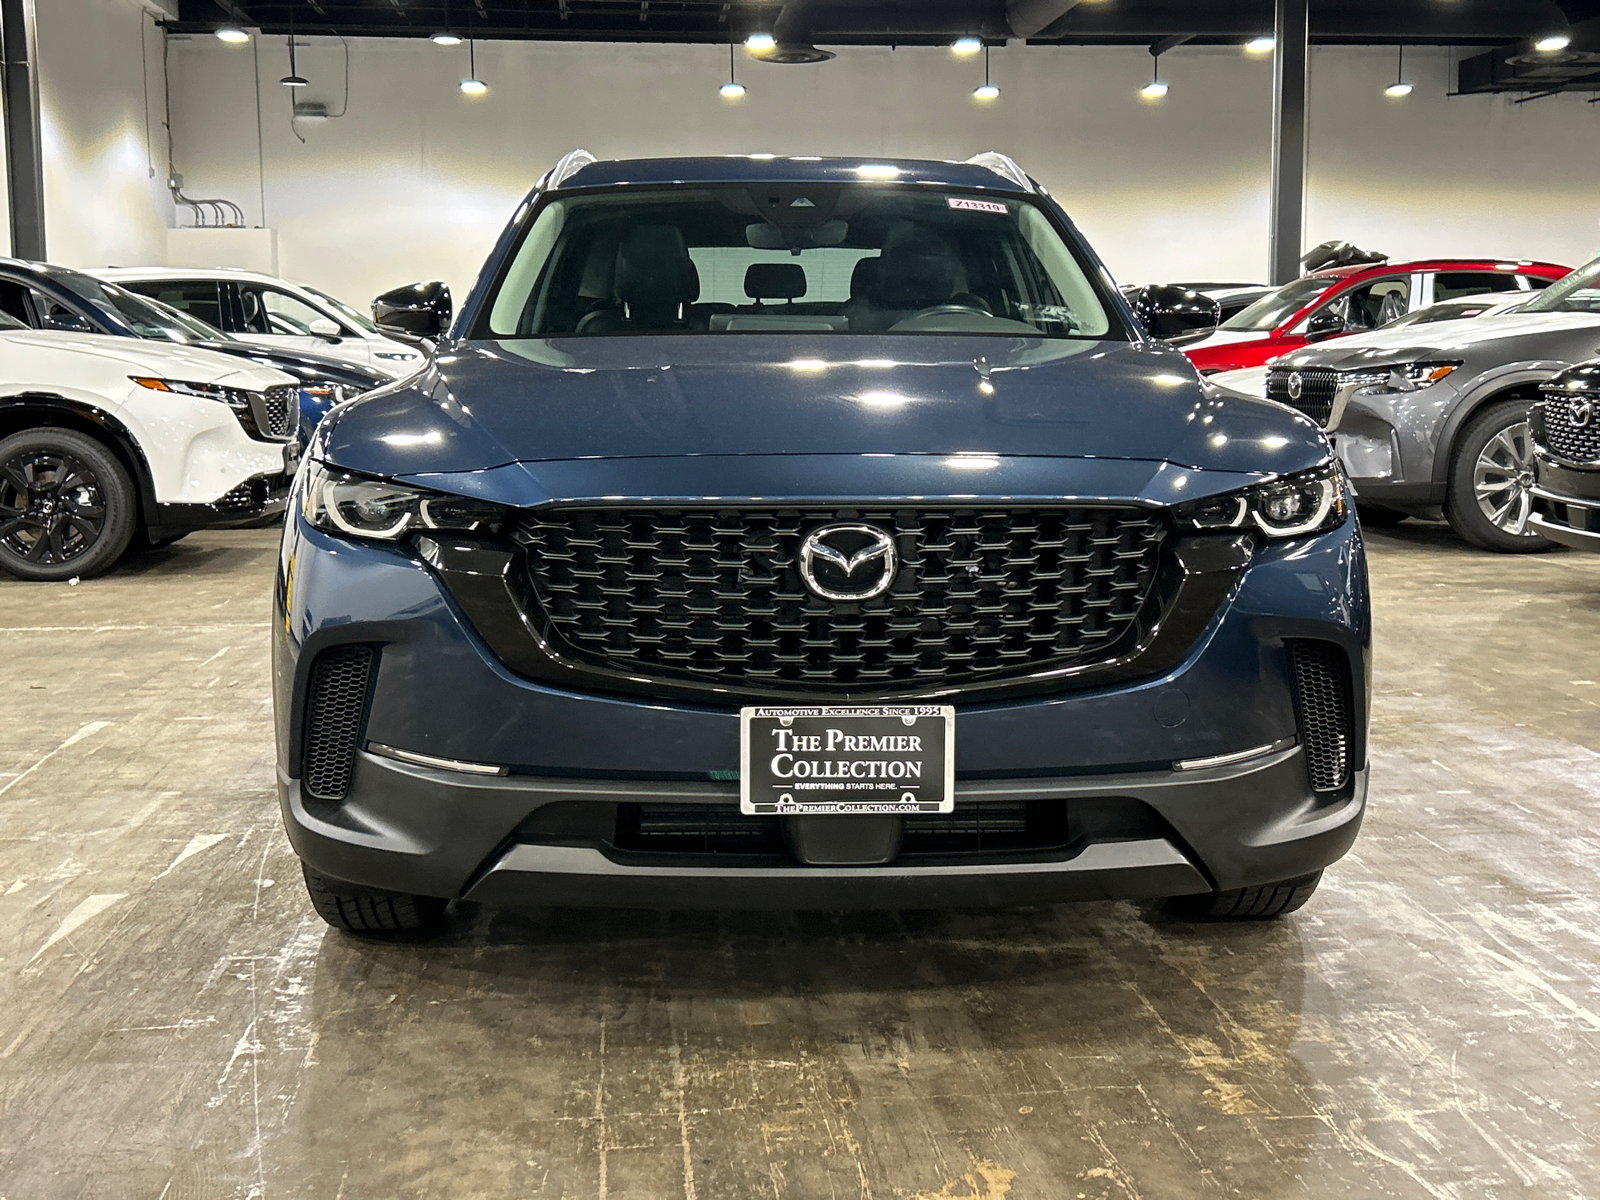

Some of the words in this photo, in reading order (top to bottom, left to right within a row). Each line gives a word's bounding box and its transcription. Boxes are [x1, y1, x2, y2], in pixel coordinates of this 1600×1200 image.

[757, 708, 819, 716] AUTOMOTIVE
[821, 708, 880, 716] EXCELLENCE
[882, 708, 911, 716] SINCE
[913, 707, 940, 716] 1995
[772, 729, 821, 752] THE
[825, 729, 922, 752] PREMIER
[770, 753, 922, 778] COLLECTION
